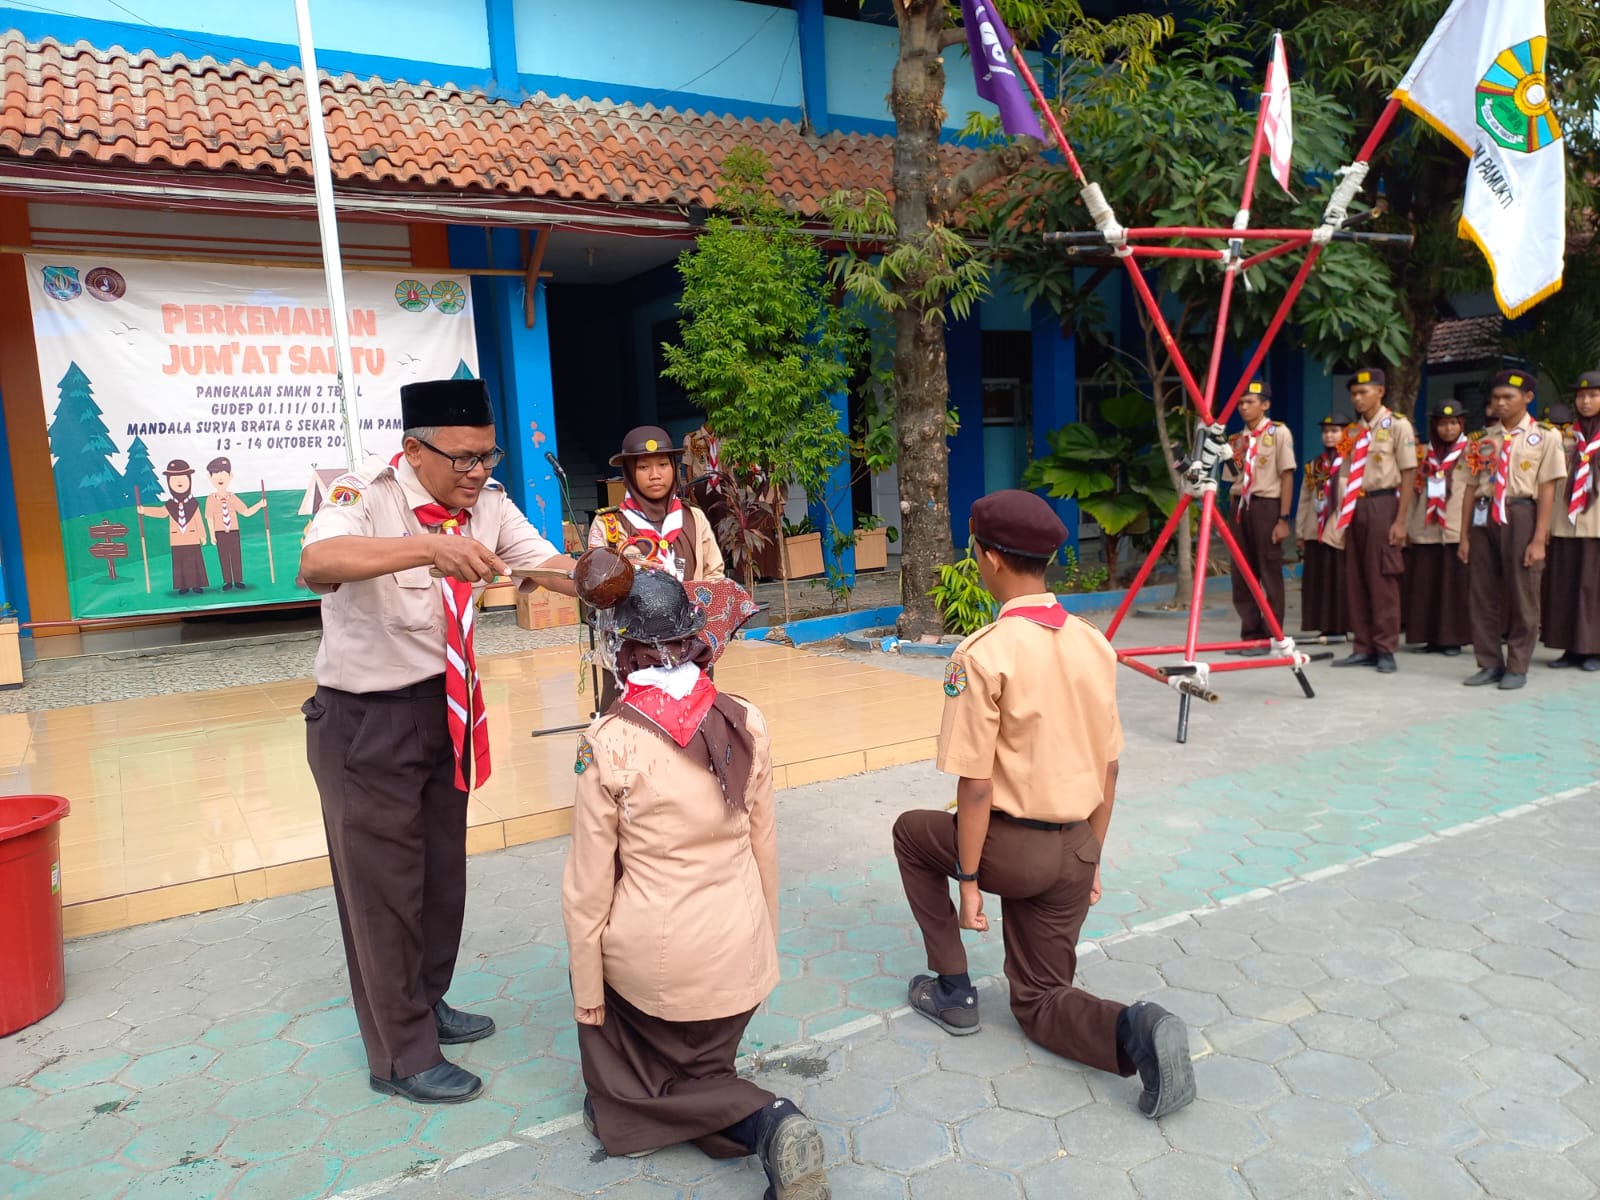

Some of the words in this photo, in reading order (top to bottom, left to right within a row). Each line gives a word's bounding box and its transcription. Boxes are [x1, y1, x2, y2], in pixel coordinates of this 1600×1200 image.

[1475, 158, 1514, 210] PAMUKTI
[161, 303, 378, 337] PERKEMAHN
[162, 341, 282, 376] JUM'AT
[196, 385, 272, 398] PANGKALAN
[276, 385, 311, 398] SMKN
[316, 385, 323, 398] 2
[327, 385, 363, 398] TEL
[211, 403, 254, 415] GUDEP
[127, 421, 192, 436] MANDALA
[196, 420, 236, 434] SURYA
[241, 419, 281, 434] BRATA
[285, 420, 293, 432] &
[297, 418, 336, 432] SEKAR
[377, 418, 402, 431] PAM
[217, 438, 231, 451] 13
[248, 437, 262, 451] 14
[267, 436, 322, 450] OKTOBER
